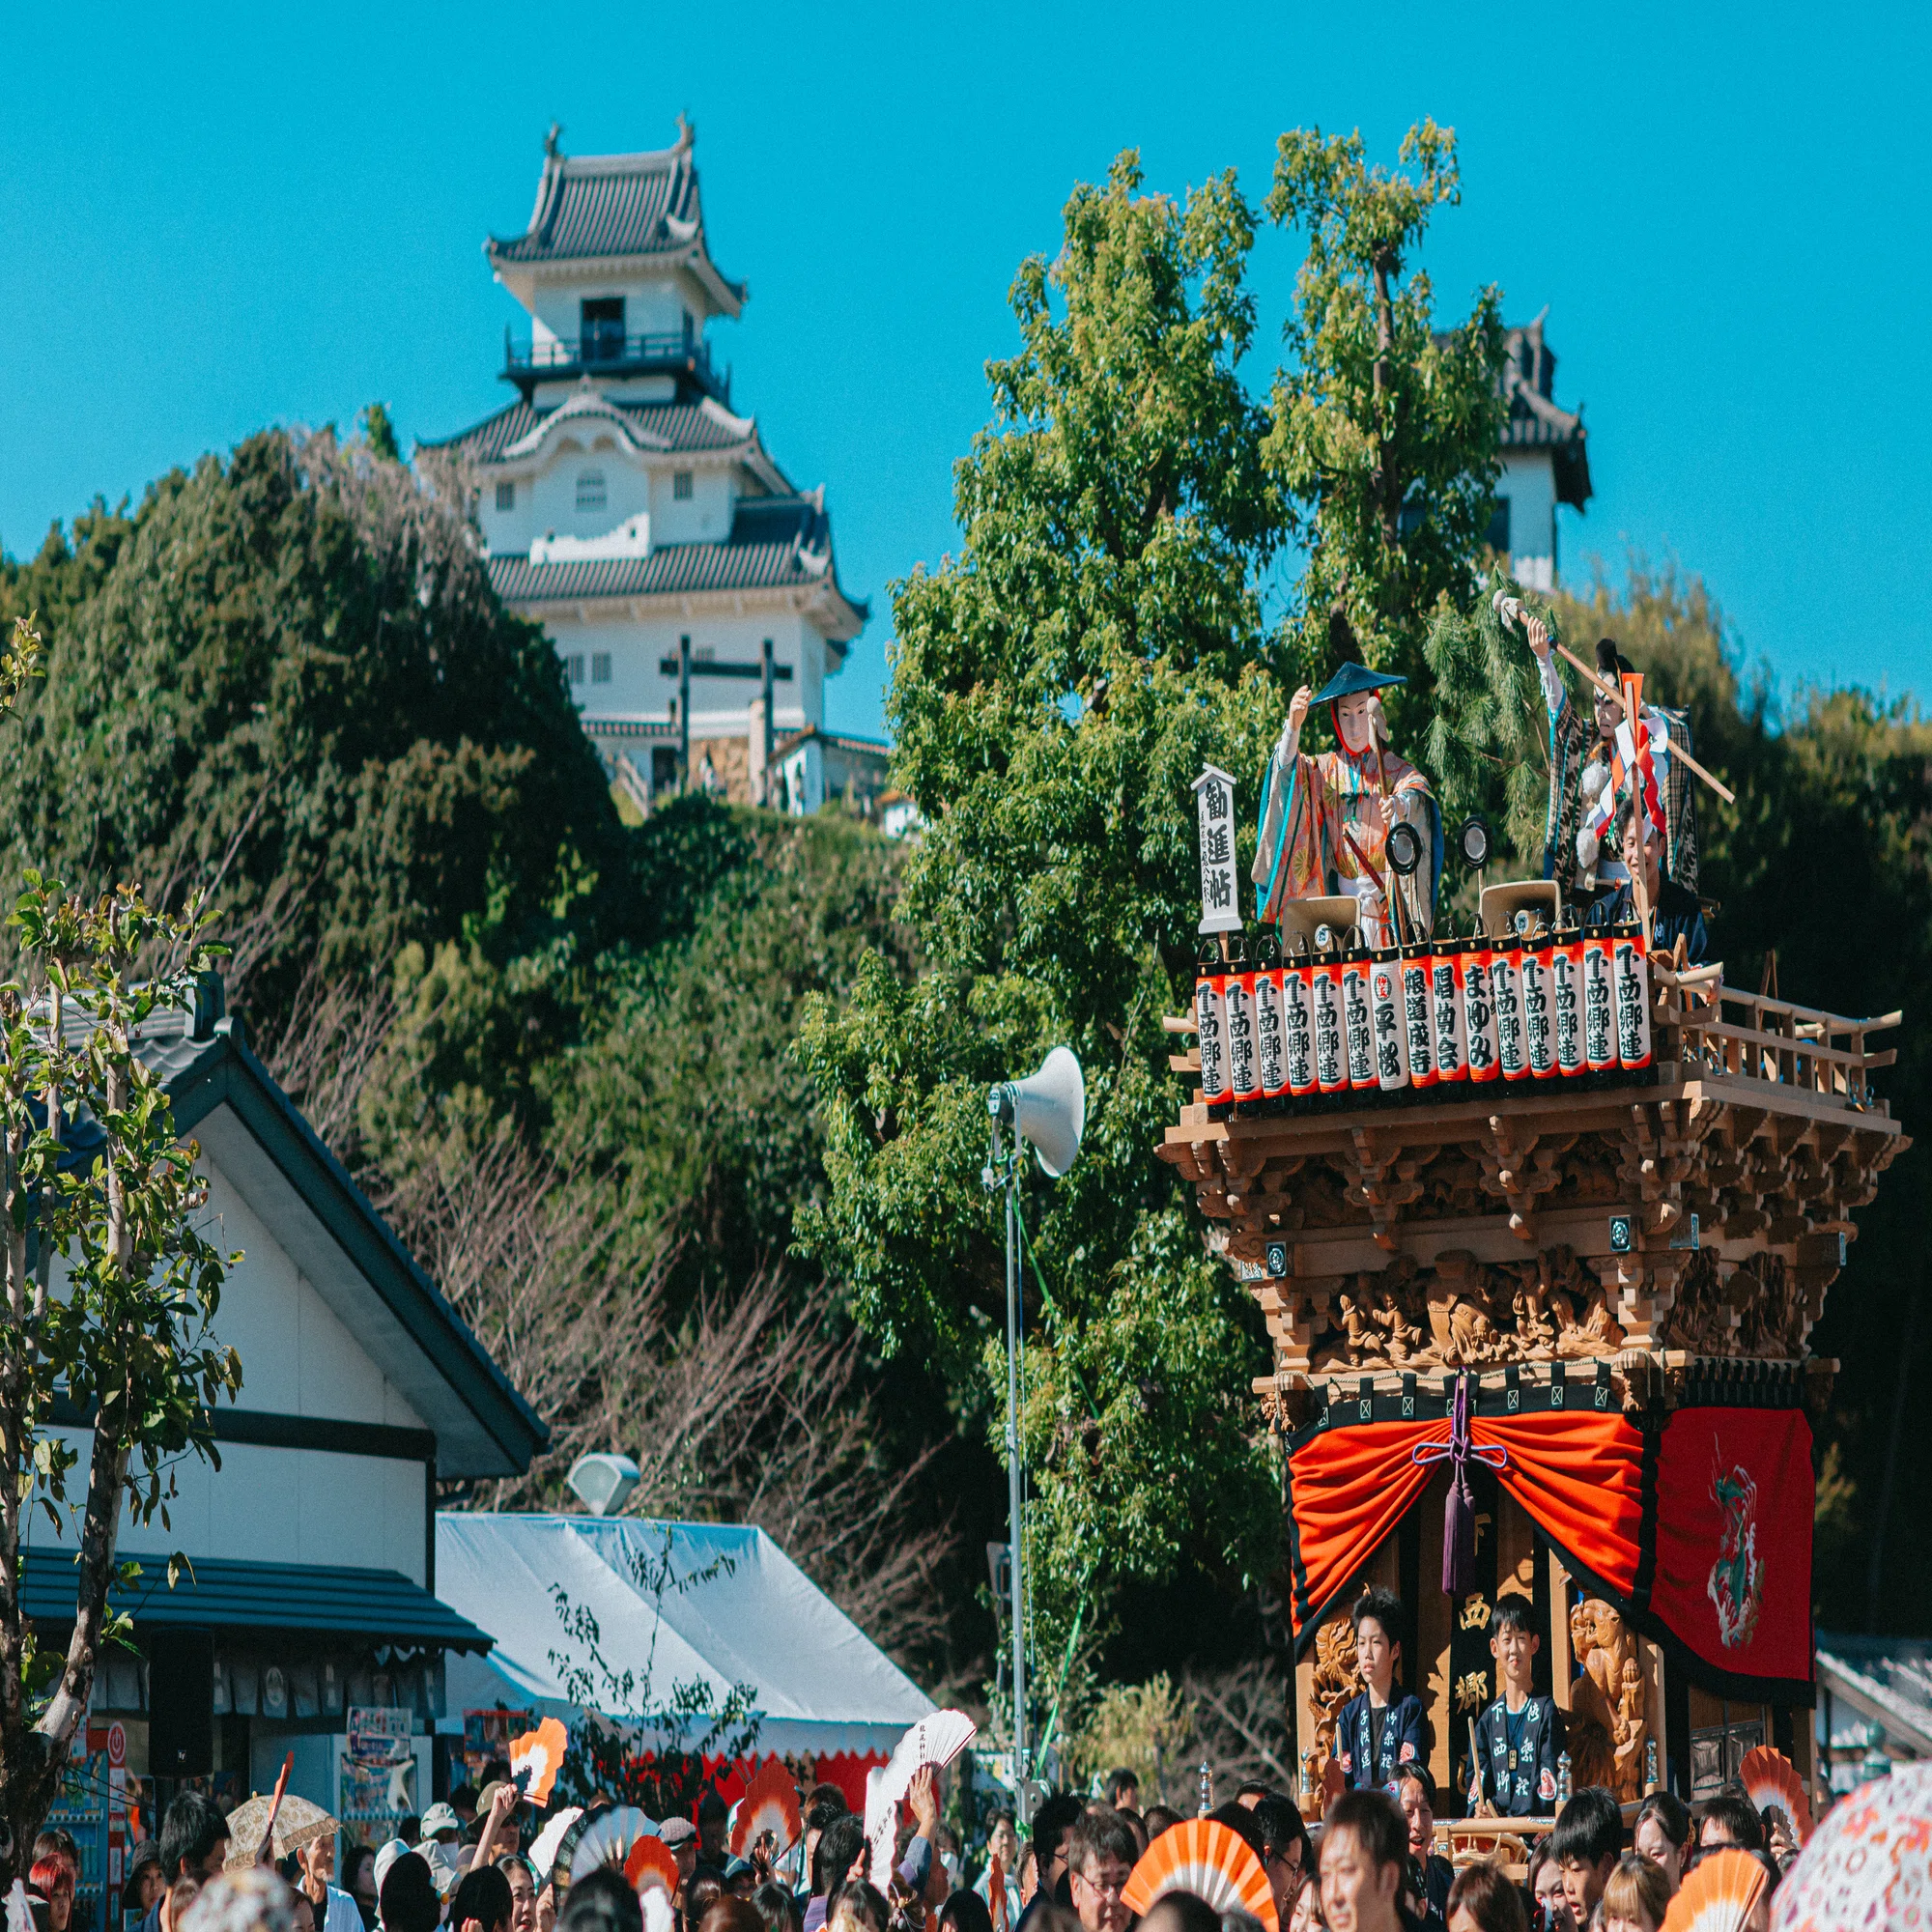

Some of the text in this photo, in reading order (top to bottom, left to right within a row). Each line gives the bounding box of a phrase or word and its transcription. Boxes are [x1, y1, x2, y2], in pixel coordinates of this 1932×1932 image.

[1197, 982, 1223, 1094] 下西郷連
[1227, 983, 1256, 1094] 下西郷連
[1256, 977, 1283, 1090] 下西郷連
[1284, 973, 1313, 1085] 下西郷連
[1314, 973, 1342, 1084] 下西郷連
[1344, 970, 1373, 1081] 下西郷連
[1463, 964, 1493, 1067] まゆみ
[1493, 961, 1523, 1069] 下西郷連
[1523, 959, 1552, 1070] 下西郷連
[1553, 955, 1580, 1066] 下西郷連
[1585, 947, 1612, 1059] 下西郷連
[1615, 944, 1645, 1060] 下西郷連
